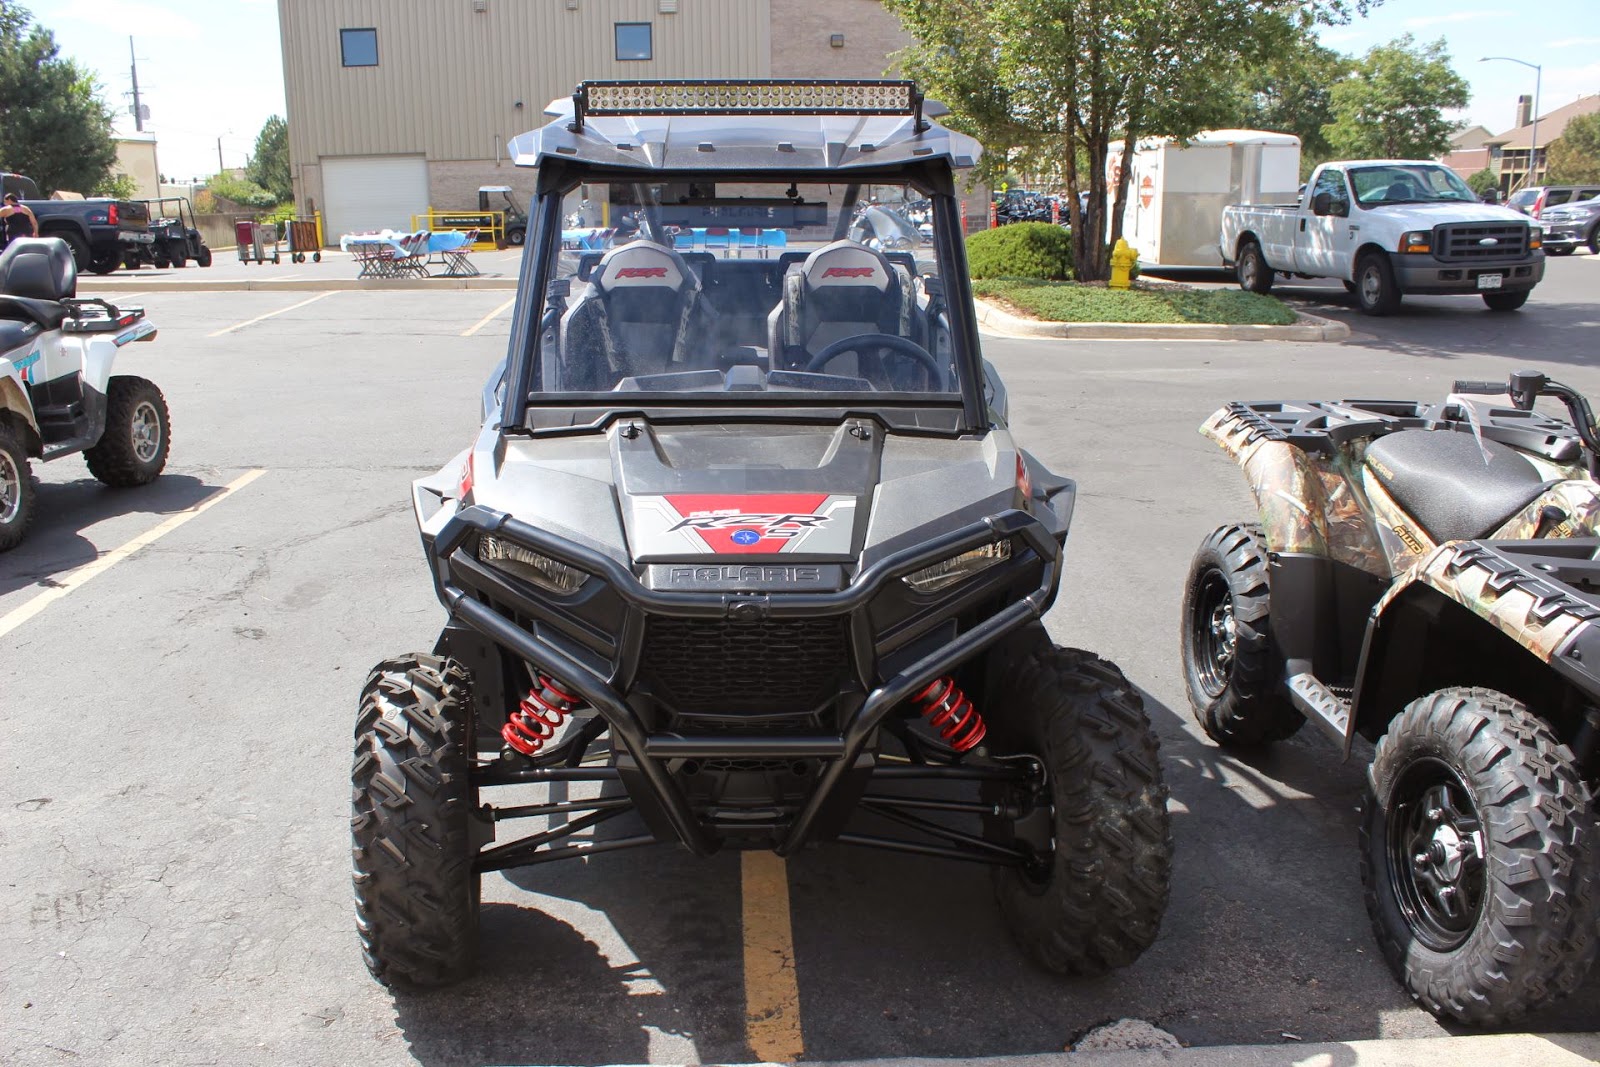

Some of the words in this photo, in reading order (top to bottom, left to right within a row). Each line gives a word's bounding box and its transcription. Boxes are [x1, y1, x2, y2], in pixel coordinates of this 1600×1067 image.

[615, 267, 667, 280] RZR
[822, 267, 874, 280] RZR
[1366, 453, 1394, 481] POLARIS
[666, 514, 831, 533] RZR
[671, 566, 821, 584] POLARIS
